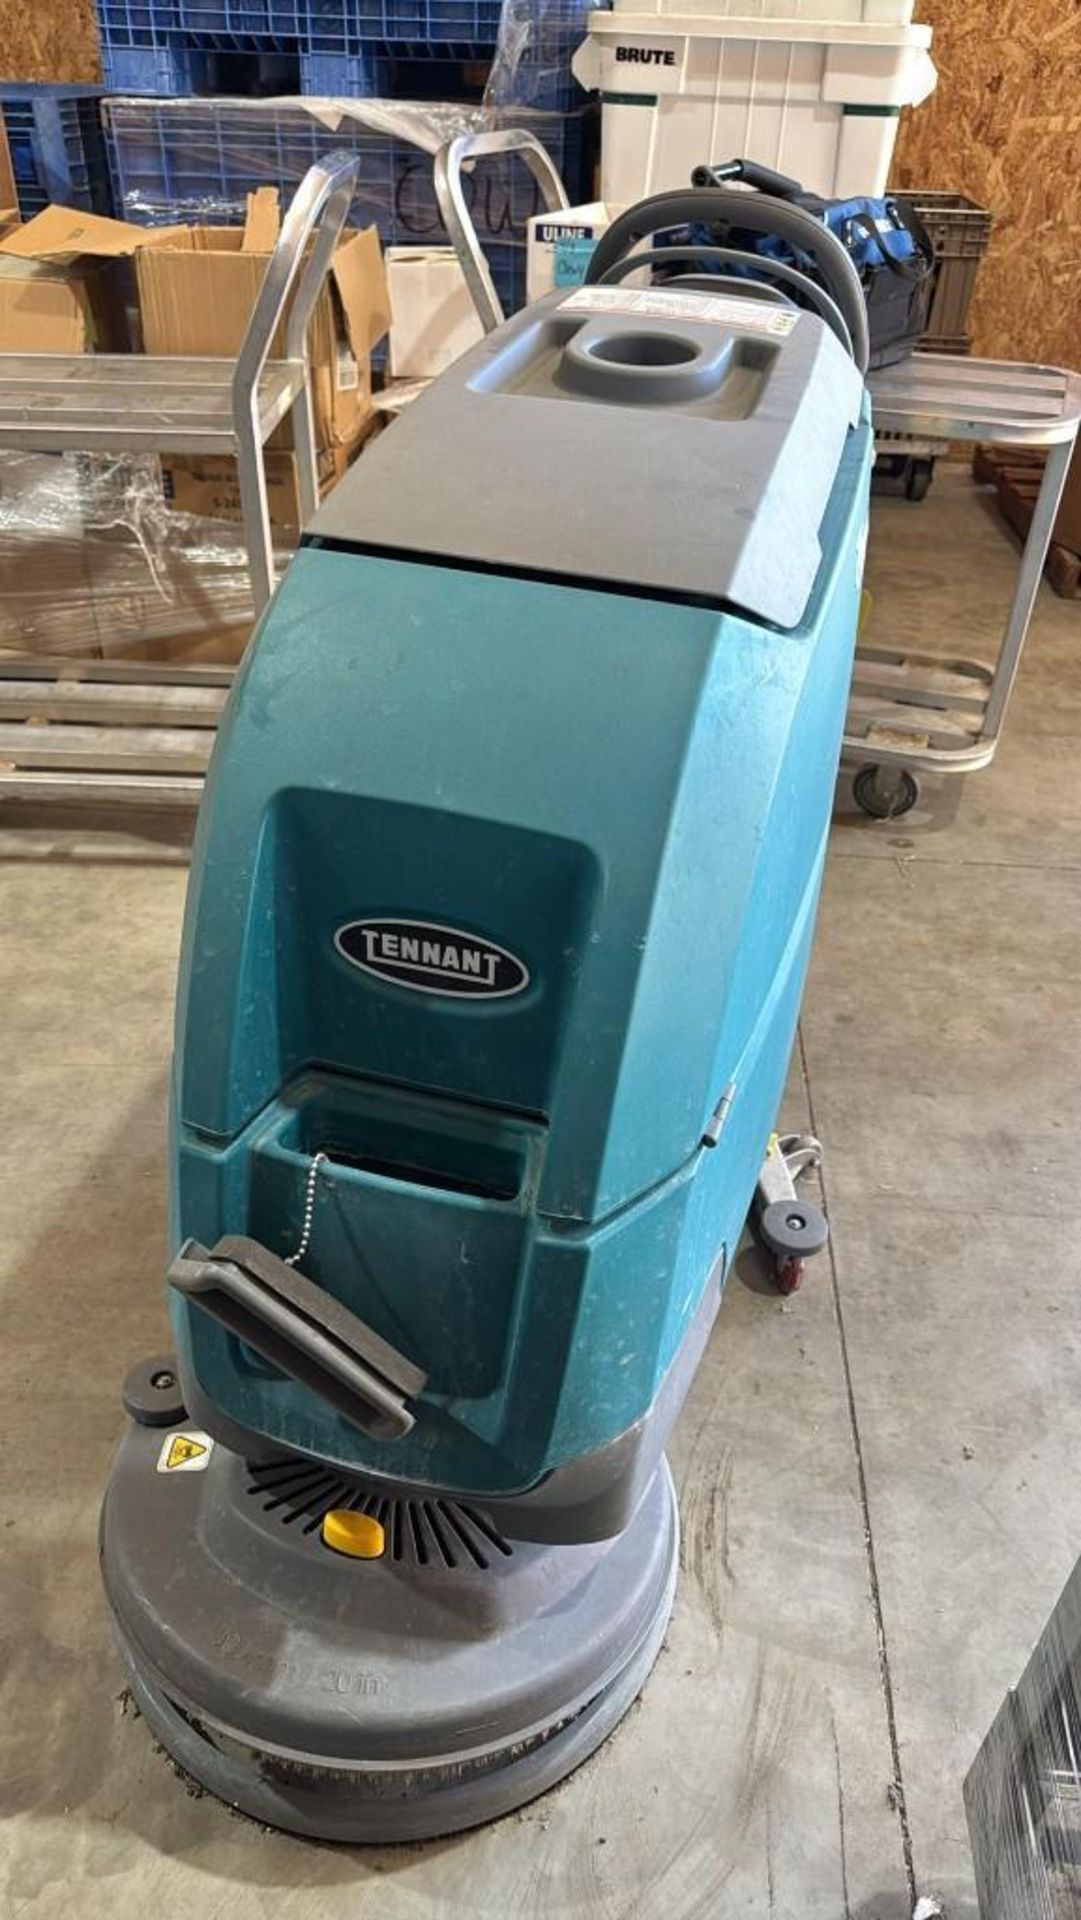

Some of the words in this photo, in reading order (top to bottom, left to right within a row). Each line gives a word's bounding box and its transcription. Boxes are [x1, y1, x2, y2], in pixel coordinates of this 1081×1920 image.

[616, 46, 675, 66] BRUTE
[542, 226, 586, 241] ULINE
[361, 929, 500, 985] TENNANT
